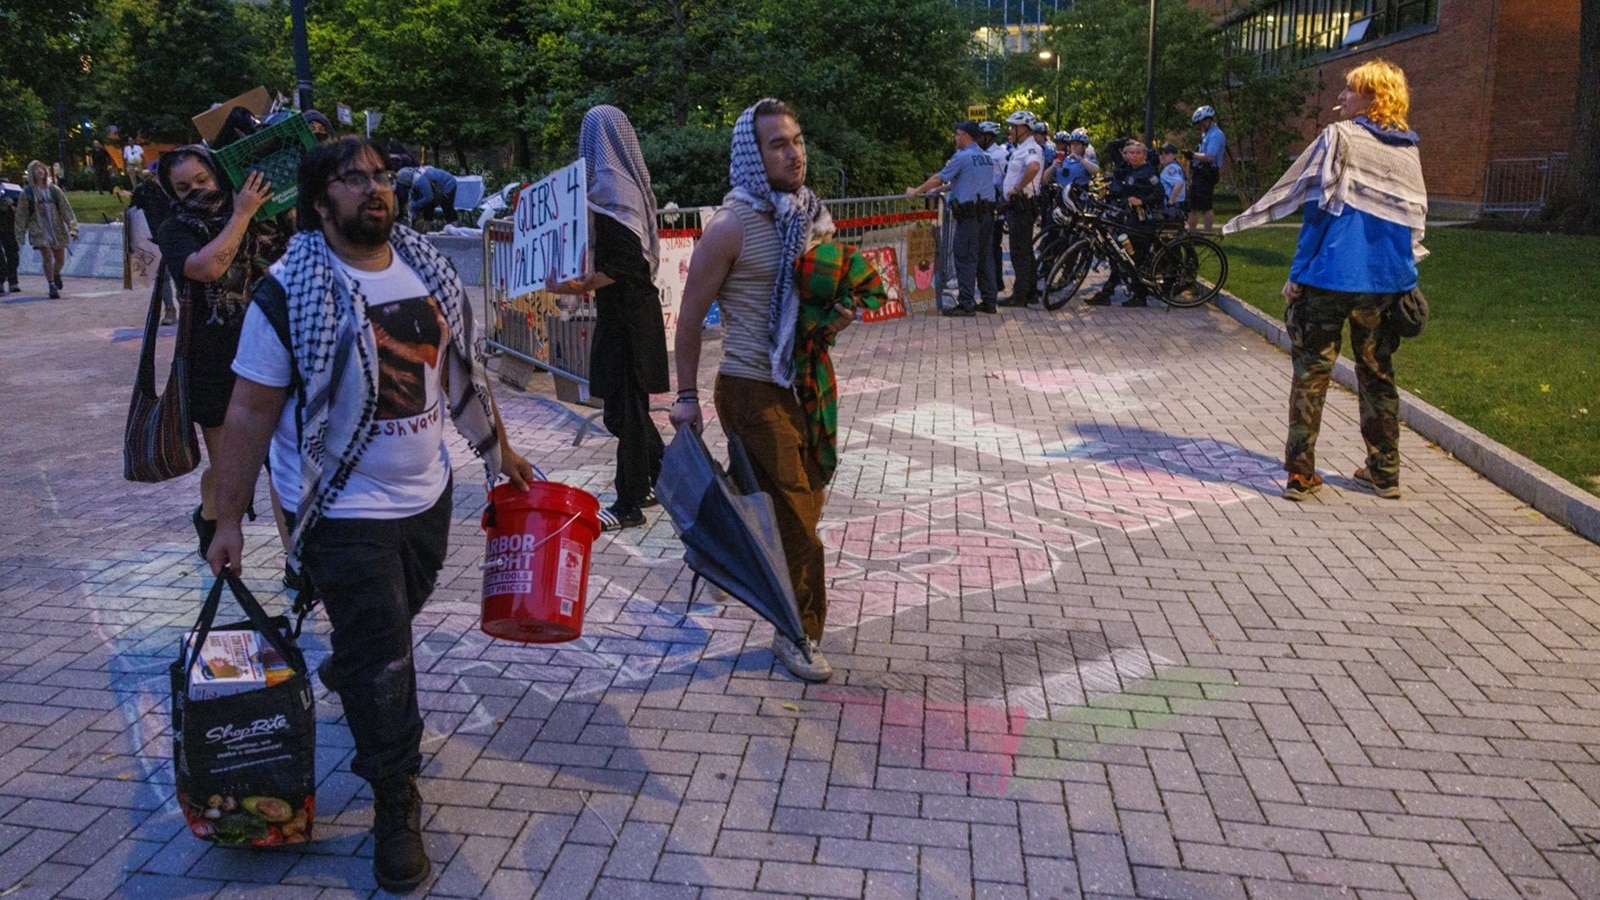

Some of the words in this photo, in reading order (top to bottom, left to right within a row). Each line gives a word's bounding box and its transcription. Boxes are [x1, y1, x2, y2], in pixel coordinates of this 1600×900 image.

[518, 177, 559, 233] QUEERS
[567, 166, 580, 218] 4
[513, 219, 578, 292] PALESTINE!
[496, 584, 528, 593] PRICES
[501, 572, 529, 581] TOOLS
[205, 714, 287, 744] ShopRite
